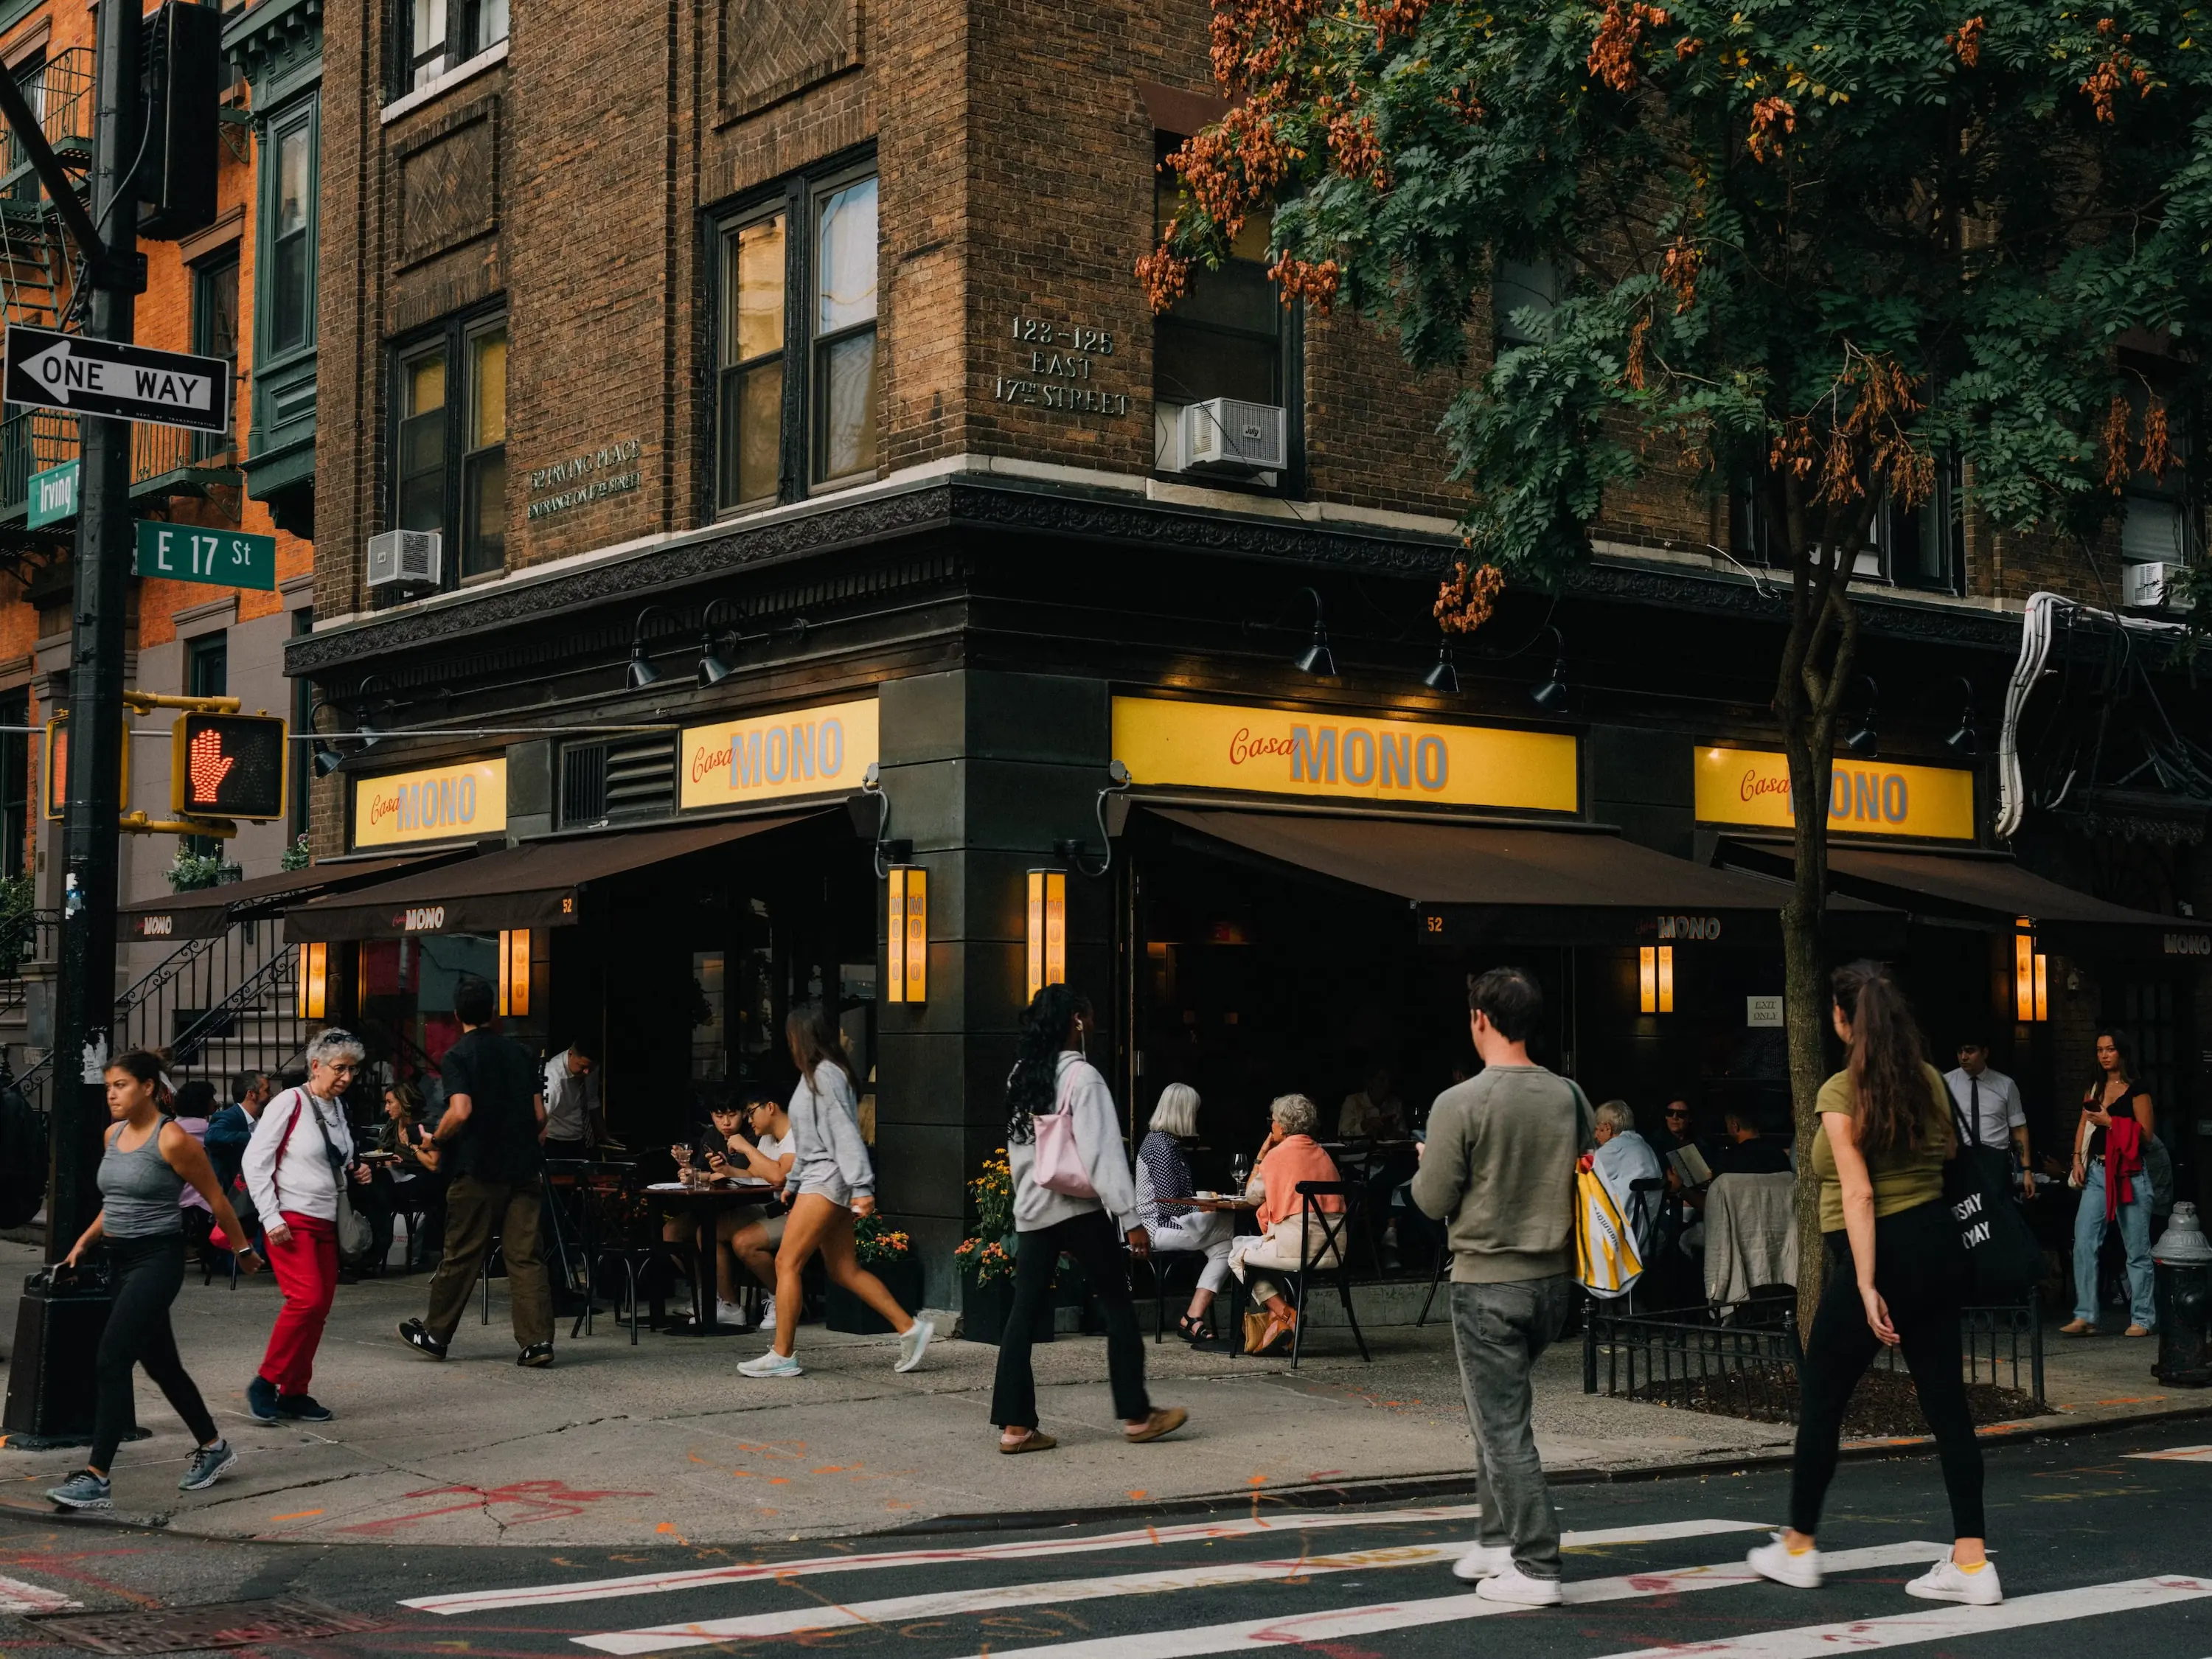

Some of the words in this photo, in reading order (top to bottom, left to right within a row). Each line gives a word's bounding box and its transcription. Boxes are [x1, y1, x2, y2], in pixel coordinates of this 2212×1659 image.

[42, 355, 104, 392] ONE
[135, 369, 199, 404] WAY
[1031, 351, 1093, 380] EAST
[1042, 384, 1130, 416] STREET
[167, 416, 217, 428] TRANSPORTATION
[530, 469, 546, 491] 52
[547, 453, 593, 486] IRVING
[597, 439, 641, 470] PLACE
[40, 472, 72, 515] Irving
[527, 492, 572, 519] ENTRANCE
[573, 488, 588, 505] ON
[608, 470, 642, 493] STREET
[157, 530, 173, 571] E
[190, 535, 219, 576] 17
[232, 540, 251, 566] St
[692, 746, 737, 784] Casa
[729, 716, 845, 791] MONO
[1229, 727, 1300, 765] Casa
[1289, 722, 1450, 793] MONO
[370, 794, 402, 826] Casa
[397, 773, 477, 832] MONO
[1740, 769, 1793, 802] Casa
[1787, 765, 1909, 826] ONO
[405, 905, 445, 931] MONO
[563, 898, 572, 914] 52
[144, 915, 172, 935] MONO
[908, 896, 924, 981] MONO
[1427, 917, 1443, 932] 52
[1657, 915, 1721, 940] MONO
[2163, 933, 2211, 955] MONO
[1753, 1011, 1778, 1020] ONLY
[1754, 1000, 1777, 1009] EXIT
